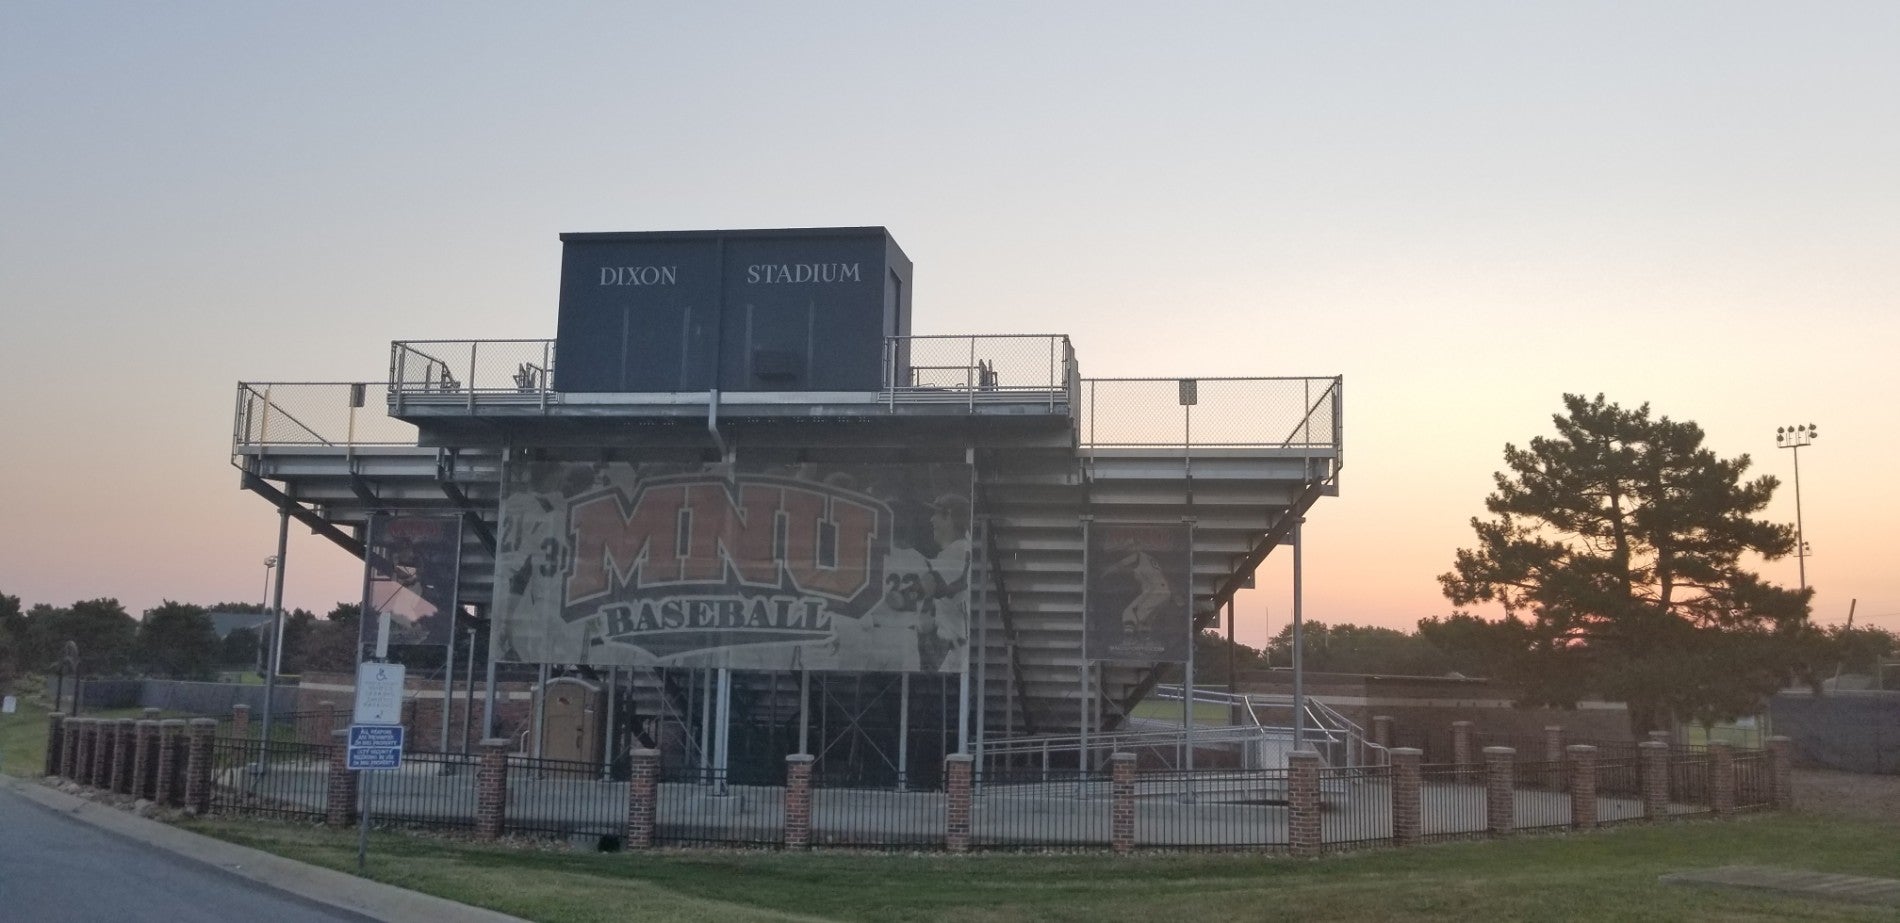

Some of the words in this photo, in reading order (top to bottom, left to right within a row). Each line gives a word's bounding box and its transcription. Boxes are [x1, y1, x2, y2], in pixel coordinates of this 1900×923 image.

[599, 265, 677, 286] DIXON
[747, 262, 862, 284] STADIUM
[565, 482, 880, 606] MNU
[604, 598, 832, 637] BASEBALL
